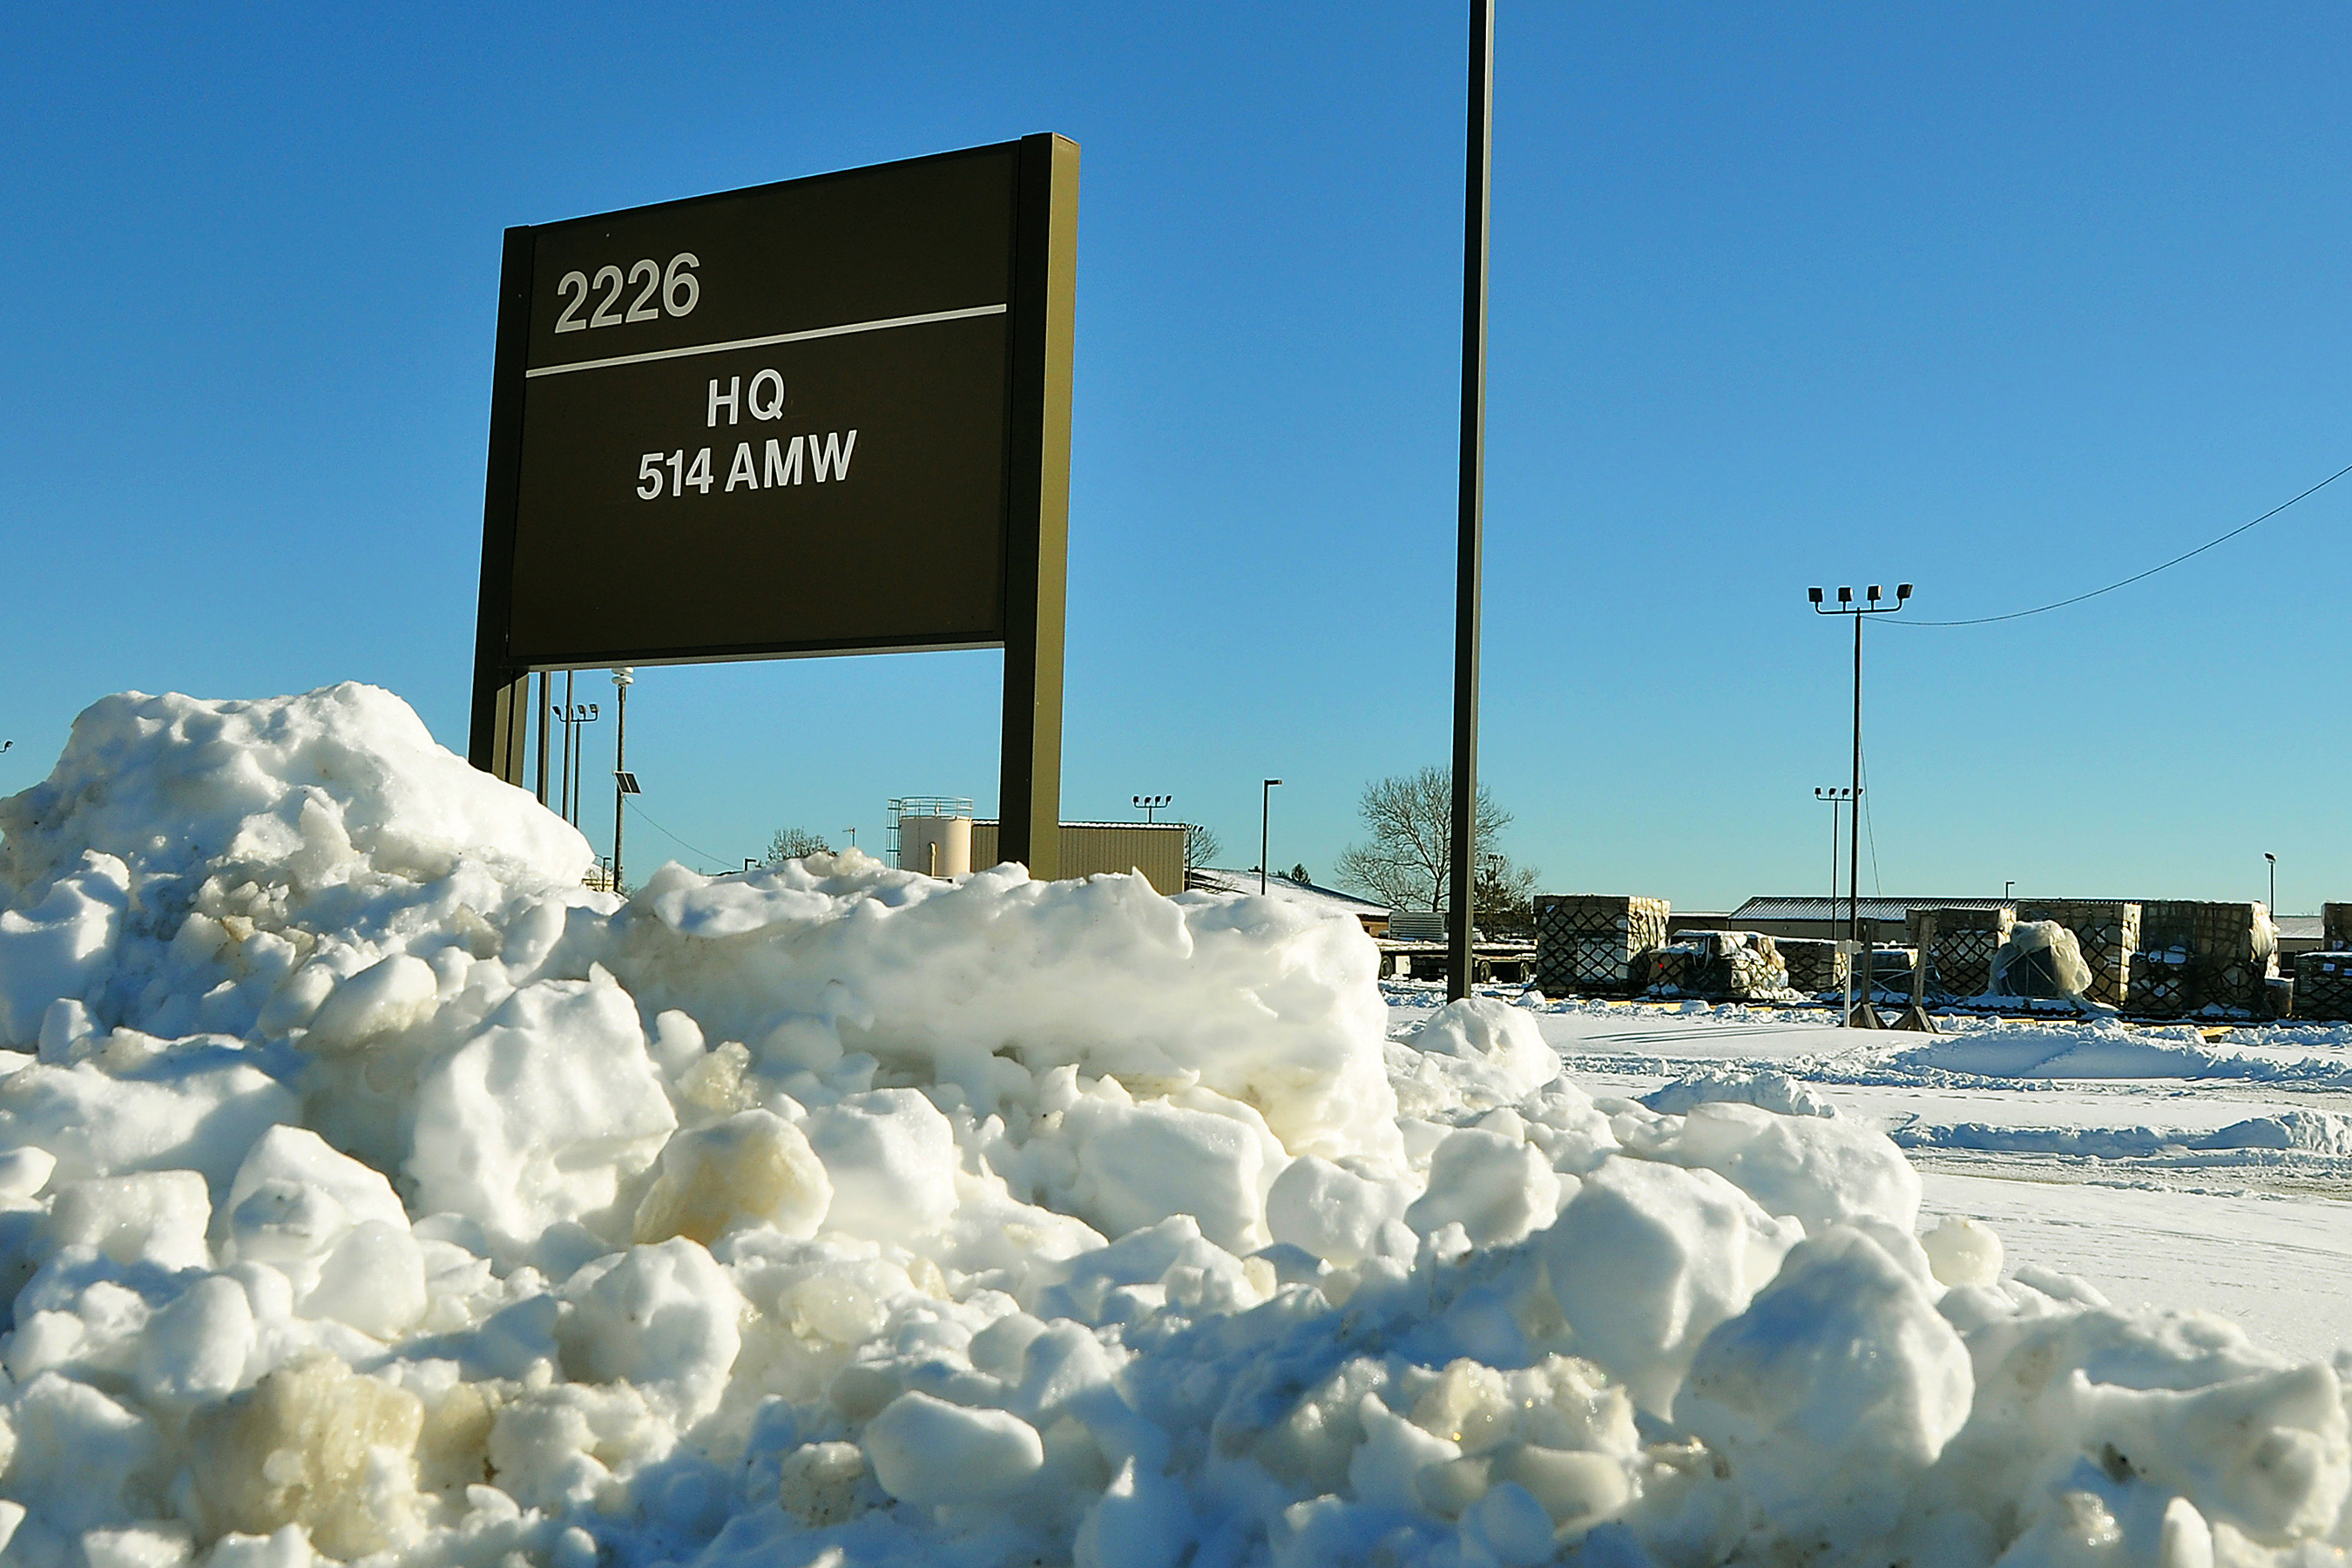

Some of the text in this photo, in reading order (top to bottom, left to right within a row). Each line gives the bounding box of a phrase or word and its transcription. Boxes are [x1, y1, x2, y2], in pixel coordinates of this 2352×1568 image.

[554, 252, 700, 334] 2226
[706, 368, 785, 428] HQ
[636, 429, 858, 500] 514 AMW
